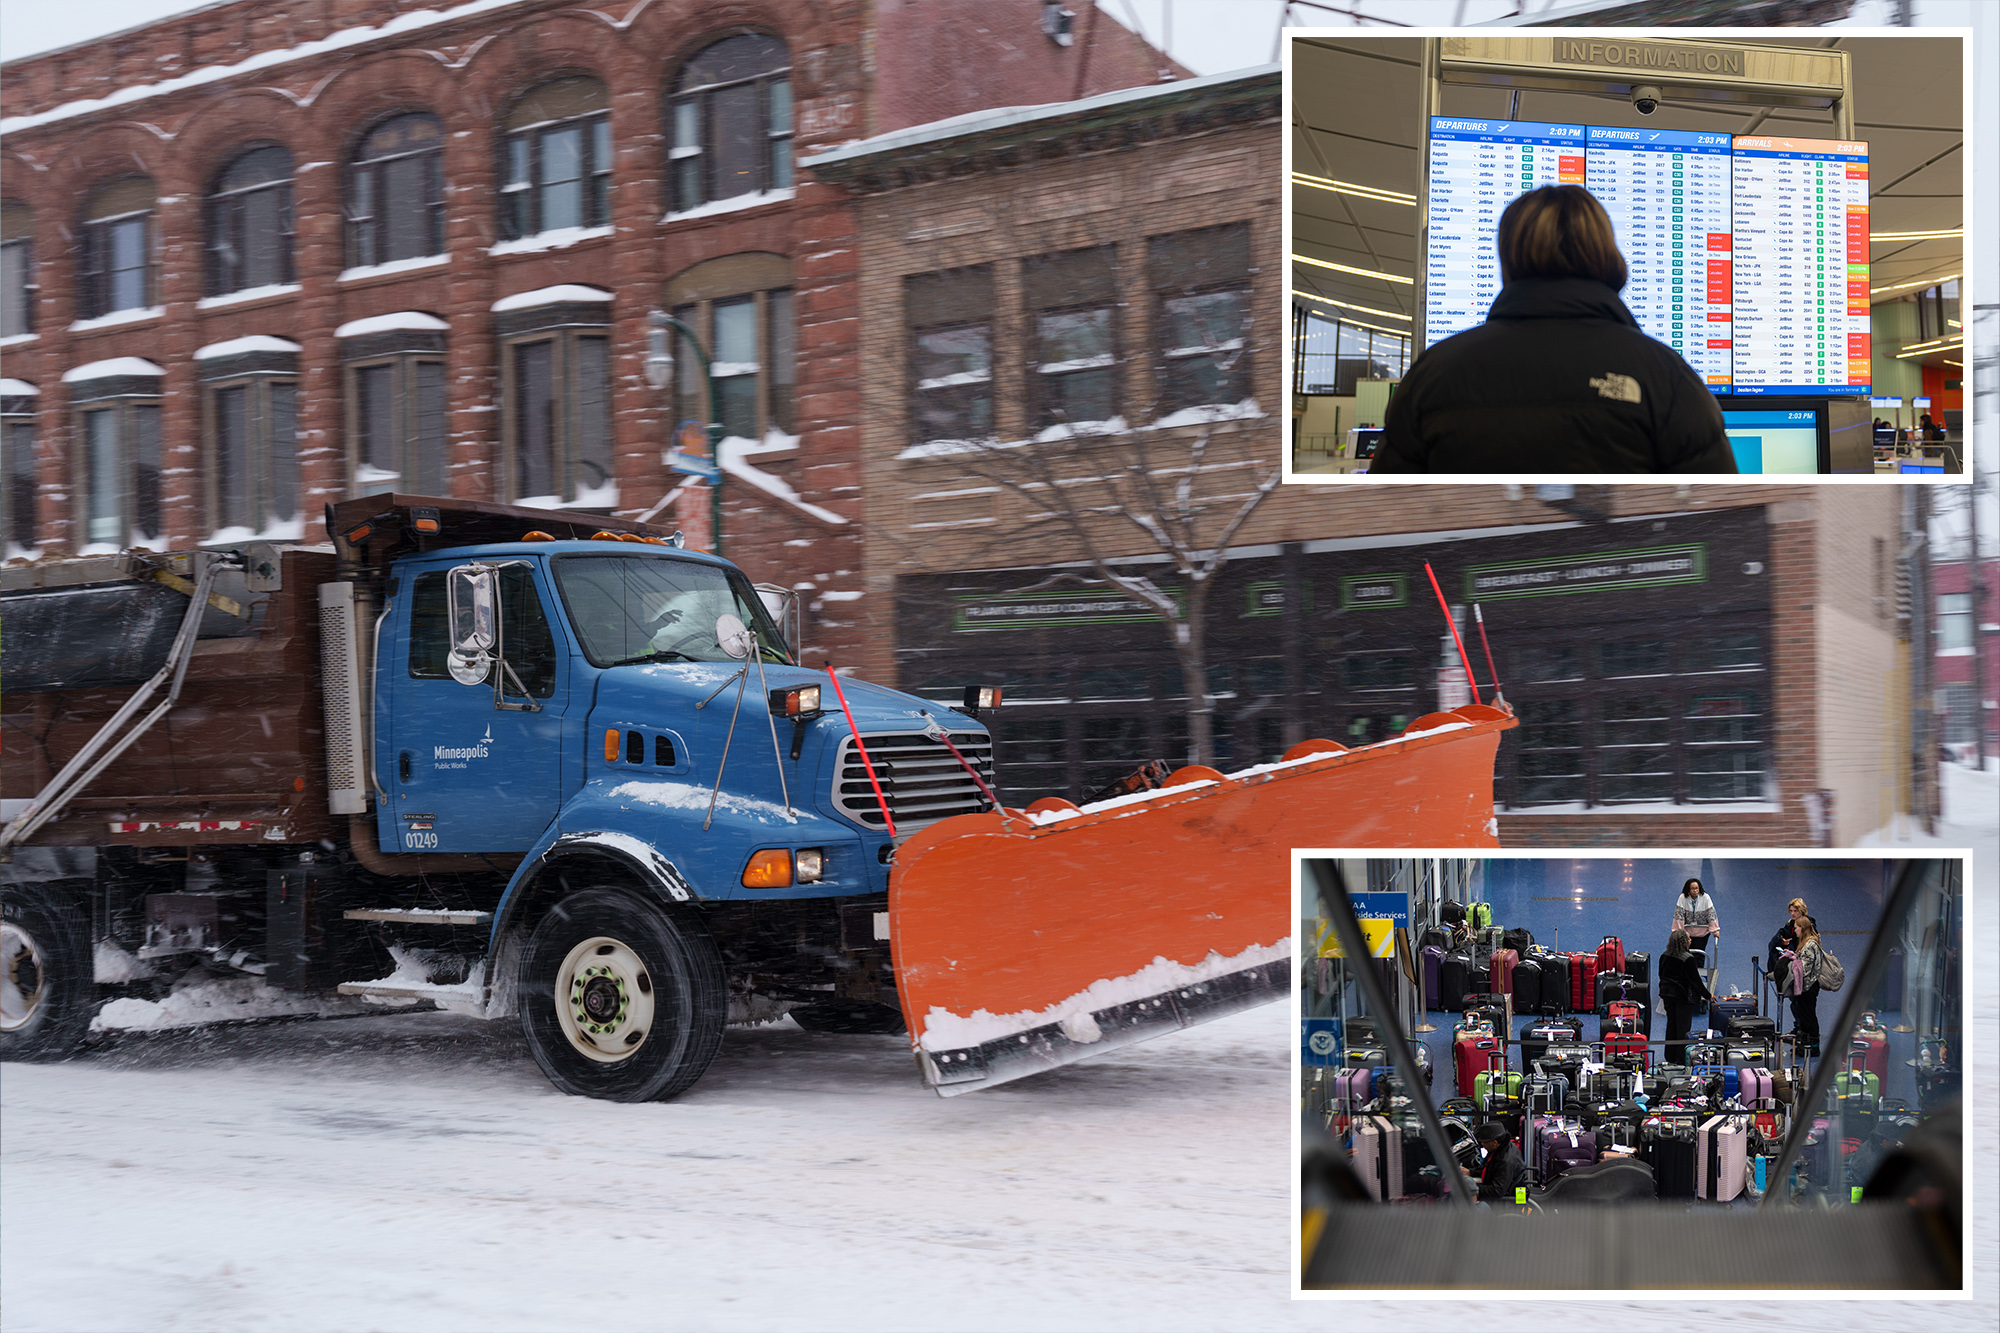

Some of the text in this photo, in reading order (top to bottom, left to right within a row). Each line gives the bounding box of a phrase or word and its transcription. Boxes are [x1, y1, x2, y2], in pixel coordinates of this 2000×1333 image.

[1561, 41, 1739, 73] INFORMATION
[1436, 121, 1488, 131] DEPARTURES
[1549, 128, 1581, 136] 2:03 PM
[1591, 130, 1640, 140] DEPARTURES
[1737, 139, 1772, 147] ARRIVALS
[1837, 144, 1852, 152] 2:03
[434, 744, 488, 761] Minneapolis
[405, 833, 438, 848] 01249
[1375, 911, 1406, 919] Services
